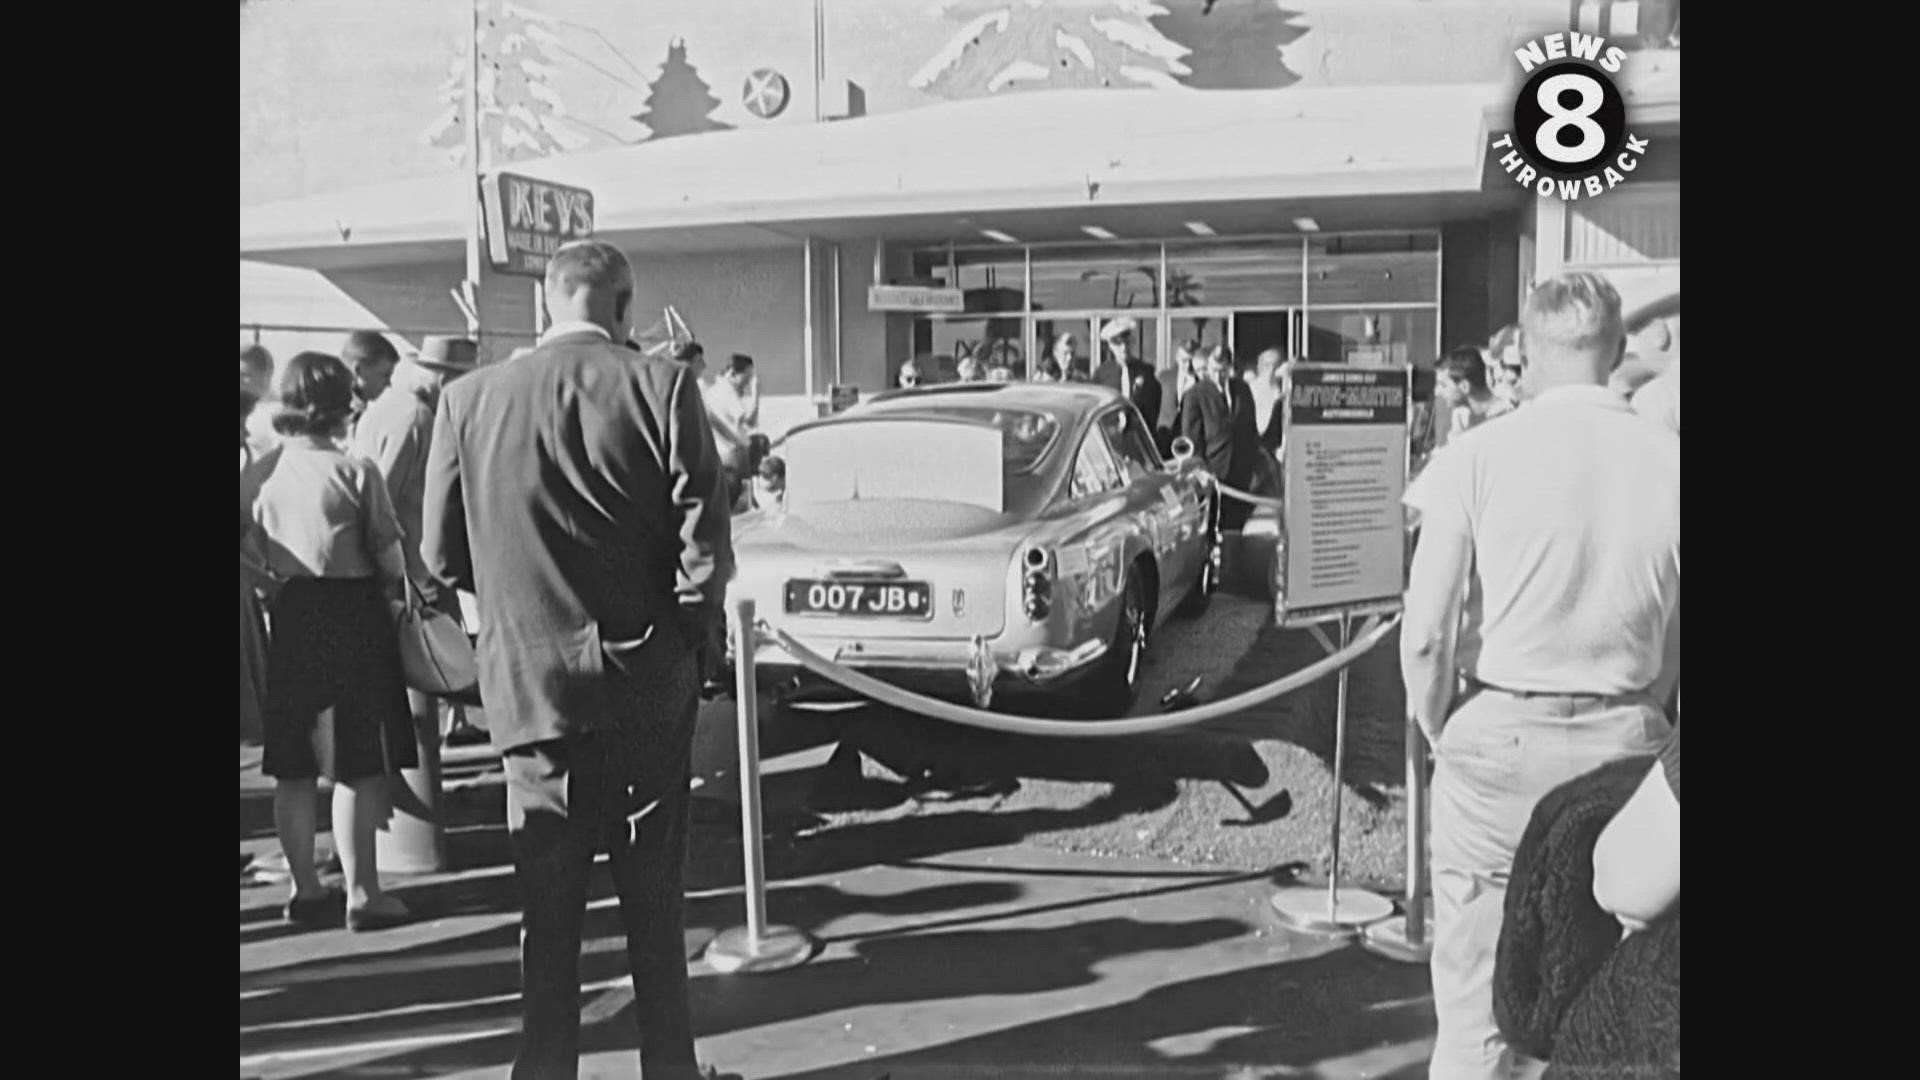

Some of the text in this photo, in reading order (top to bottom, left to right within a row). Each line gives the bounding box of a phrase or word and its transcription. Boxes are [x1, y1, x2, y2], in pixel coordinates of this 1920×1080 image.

[509, 179, 592, 236] KEYS
[1292, 385, 1403, 408] ASTON-MARTIN
[1322, 408, 1375, 419] AUTOMOBILE
[808, 584, 906, 612] 007 JB
